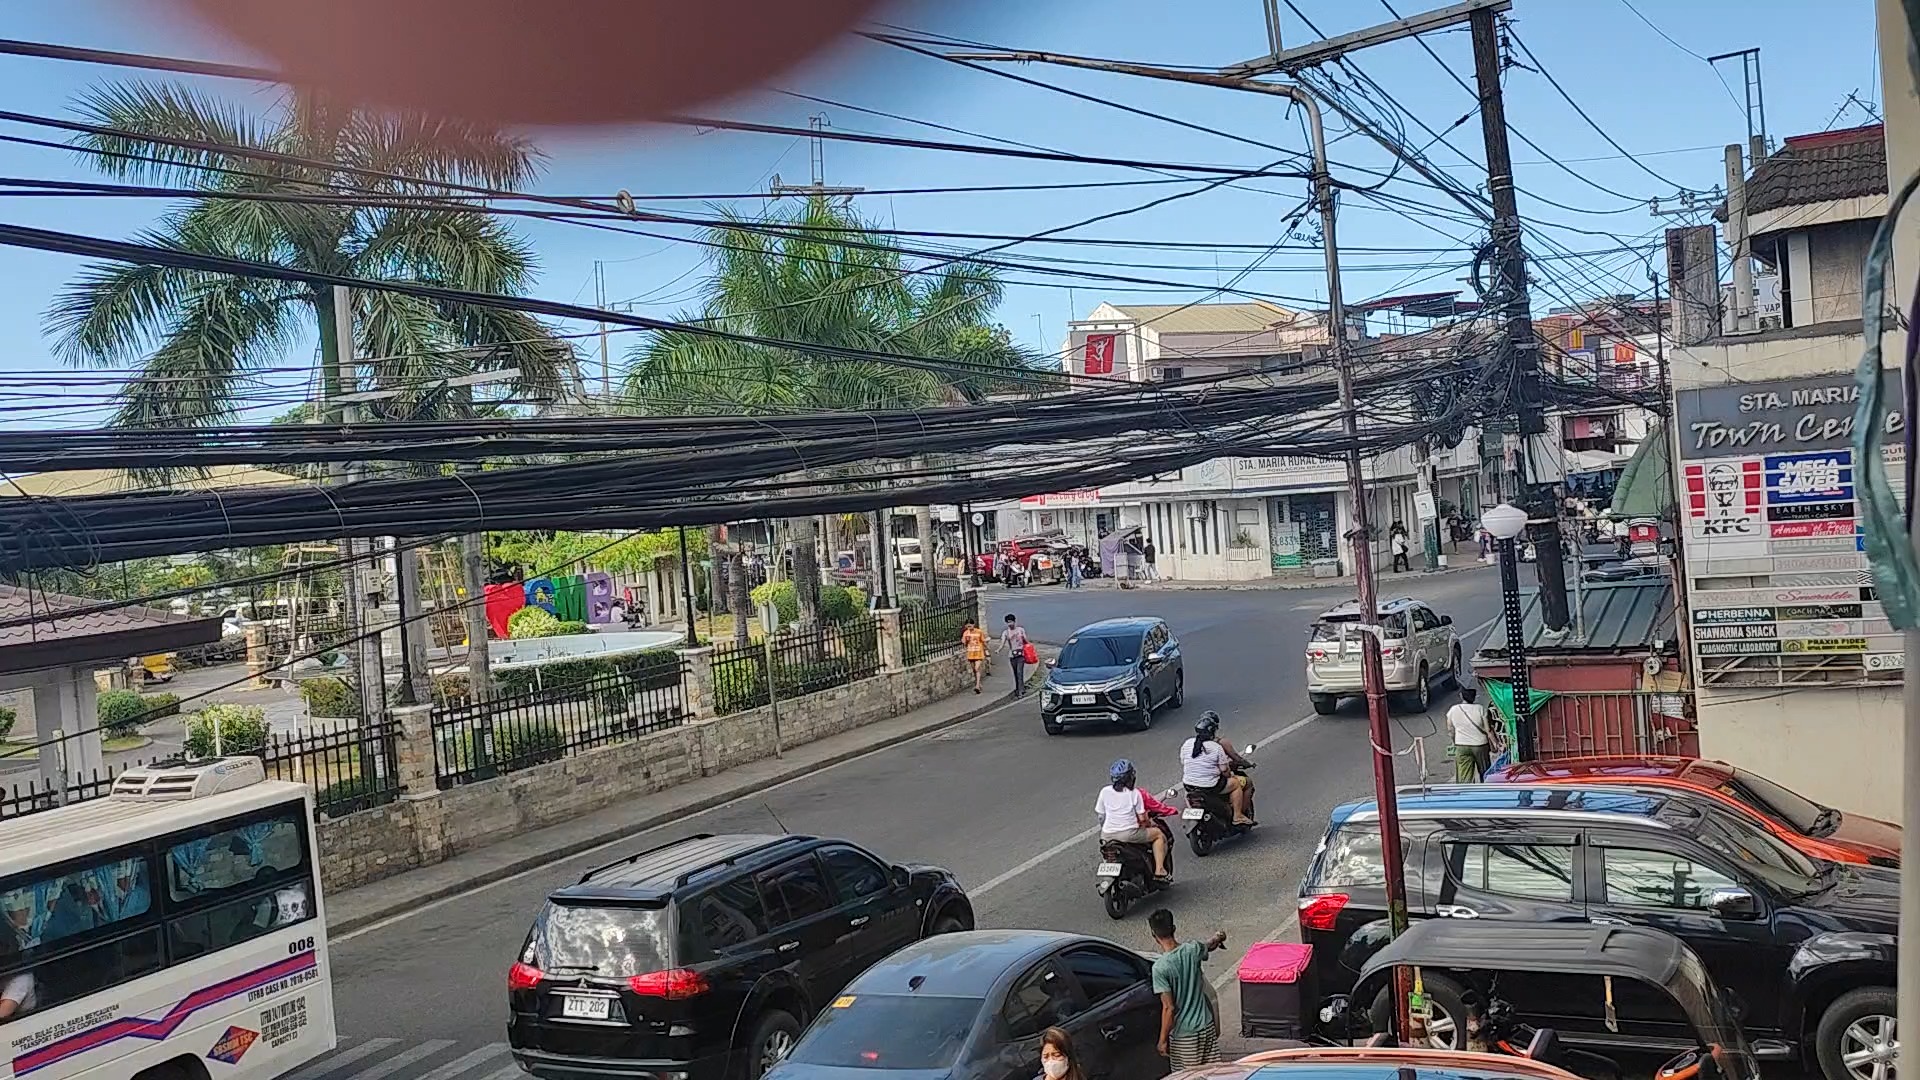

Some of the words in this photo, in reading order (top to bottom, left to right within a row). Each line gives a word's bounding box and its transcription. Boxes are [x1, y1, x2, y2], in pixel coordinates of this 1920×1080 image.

[1739, 391, 1789, 413] STA.
[1792, 386, 1862, 406] MARIA
[1691, 420, 1787, 449] Town
[1239, 459, 1257, 470] STA.
[1258, 457, 1287, 469] MARIA
[1288, 455, 1317, 467] RURAL
[1785, 459, 1840, 477] MEGA
[1779, 475, 1840, 493] SAVER
[1776, 505, 1811, 514] EARTH
[1824, 503, 1845, 512] SKY
[1702, 518, 1750, 535] KFC
[1707, 608, 1771, 619] HERBENNA
[1694, 626, 1744, 640] SHAWARMA
[1746, 625, 1776, 638] SHACK
[1701, 644, 1739, 654] DIAGNOSTIC
[1739, 642, 1778, 653] LABORATORY
[289, 936, 315, 954] 008
[265, 983, 280, 995] CASE
[589, 1000, 606, 1013] 202
[66, 1016, 84, 1027] MARIA
[20, 1035, 53, 1052] TRANSPORT
[53, 1026, 76, 1040] SERVICE
[77, 1012, 113, 1031] COOPERATIVE
